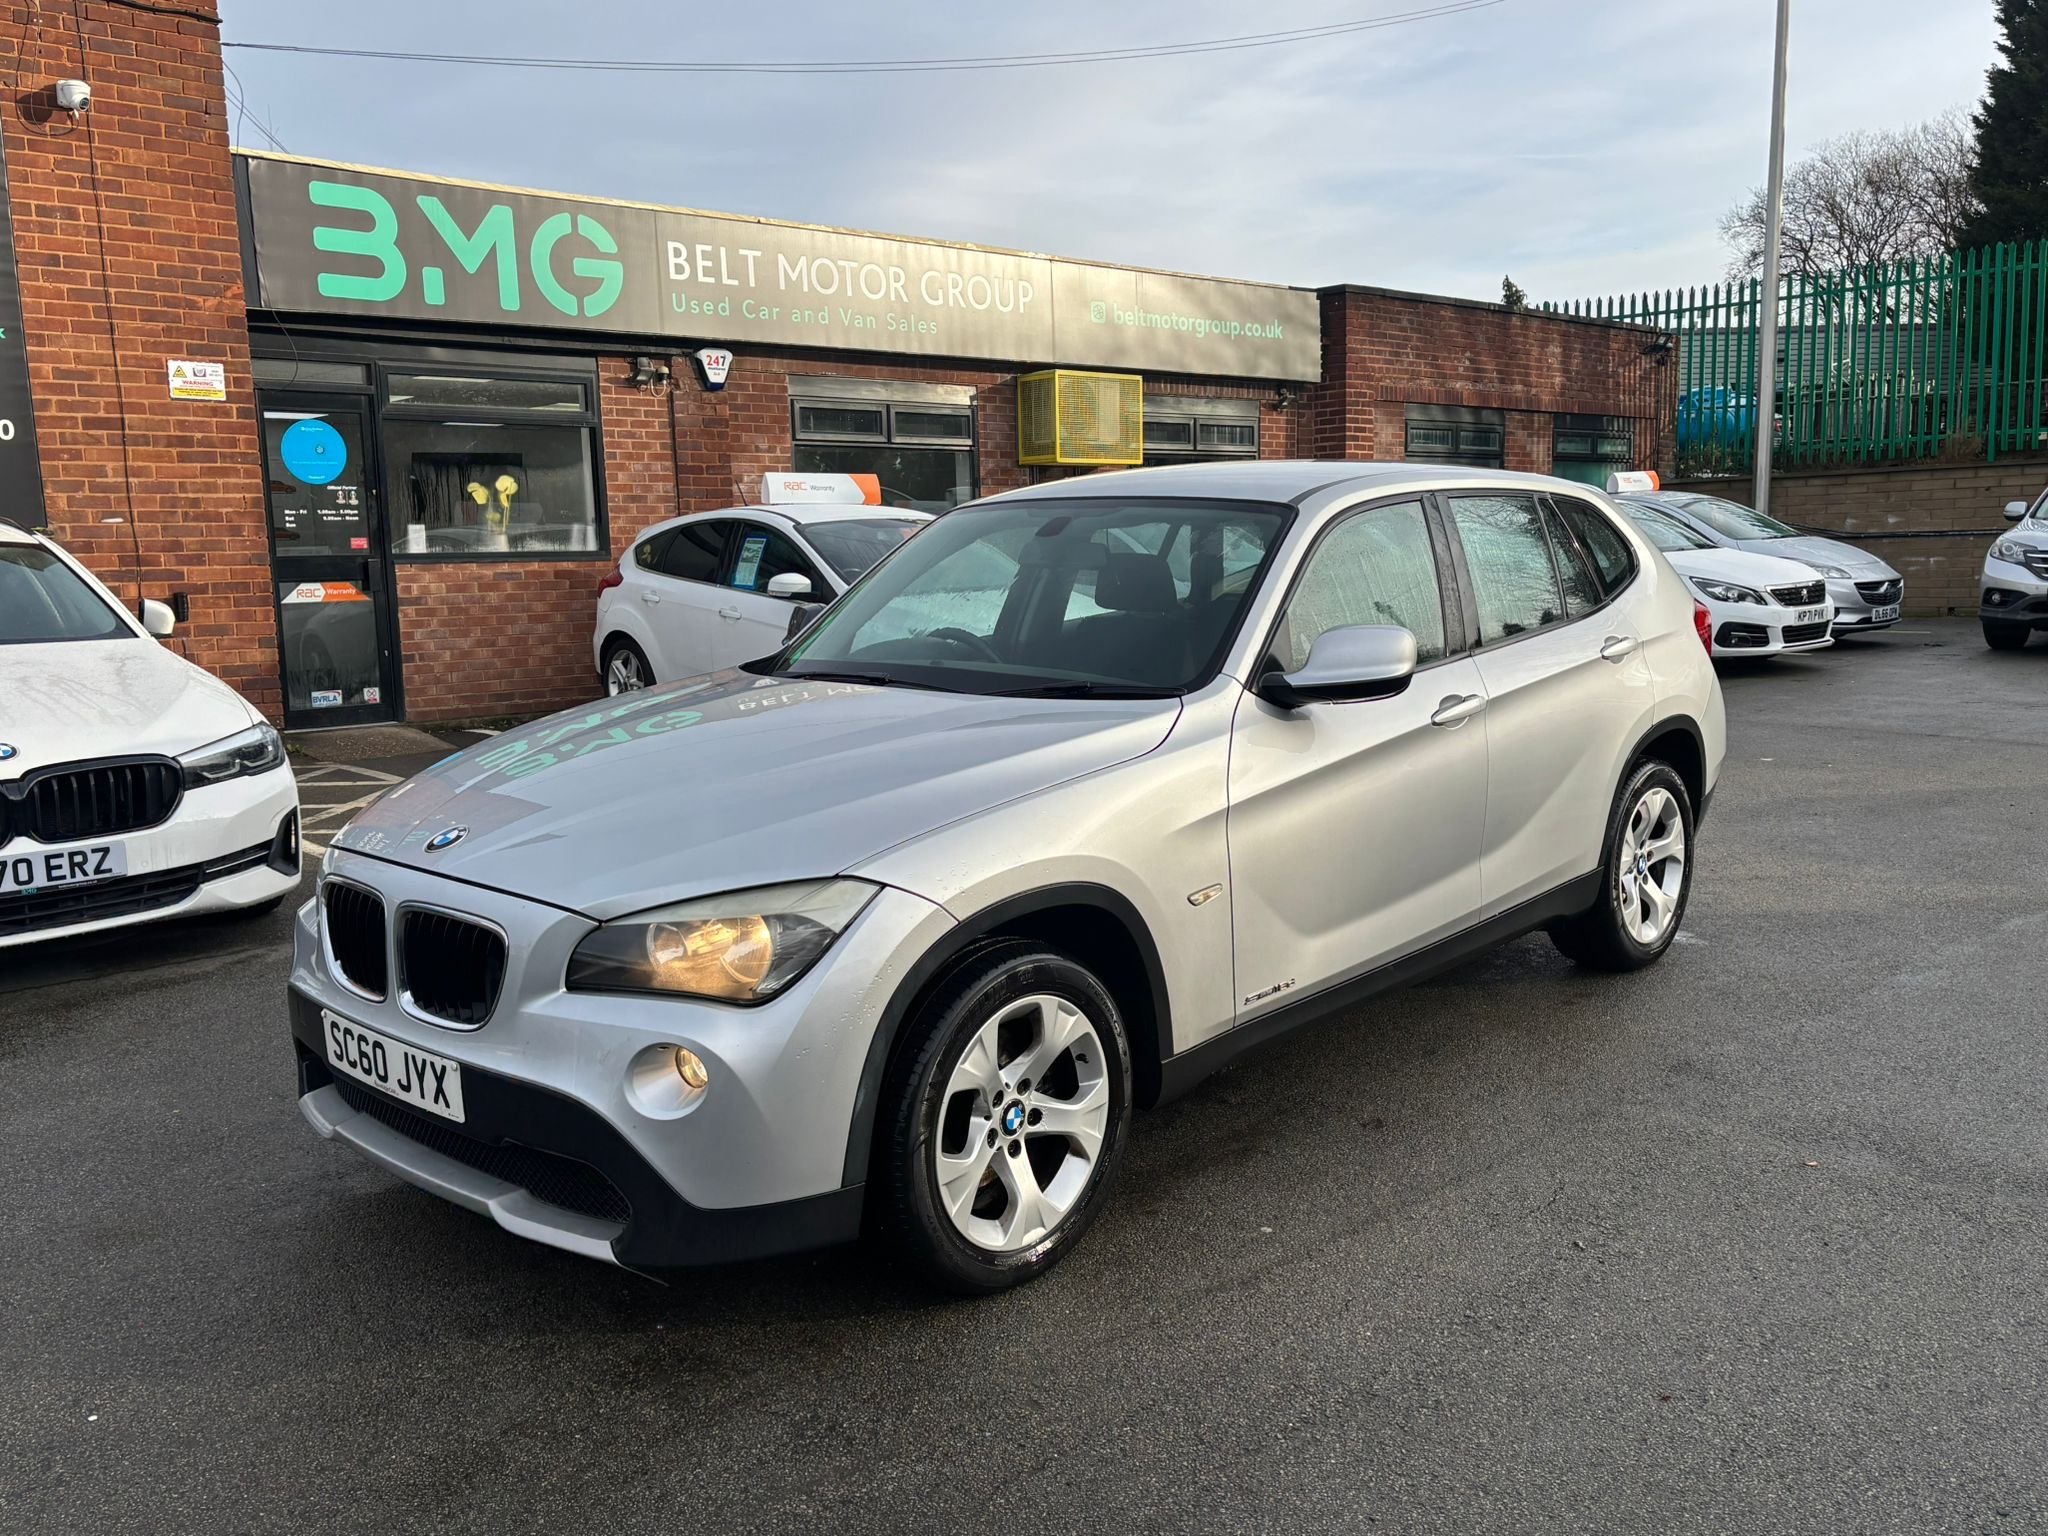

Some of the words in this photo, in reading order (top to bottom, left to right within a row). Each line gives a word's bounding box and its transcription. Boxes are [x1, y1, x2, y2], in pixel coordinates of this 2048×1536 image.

[666, 240, 762, 288] BELT
[777, 252, 909, 303] MOTOR
[920, 270, 1034, 314] GROUP
[671, 293, 730, 317] Used
[742, 300, 780, 321] Car
[791, 307, 829, 326] and
[839, 308, 876, 330] Van
[887, 312, 938, 335] Sales
[1113, 302, 1283, 340] beltmotorgroup.co.uk
[706, 354, 726, 367] 247
[312, 695, 338, 704] BVRLA
[44, 846, 113, 882] ERZ
[330, 1020, 389, 1084] SC60
[397, 1051, 450, 1109] JYX
